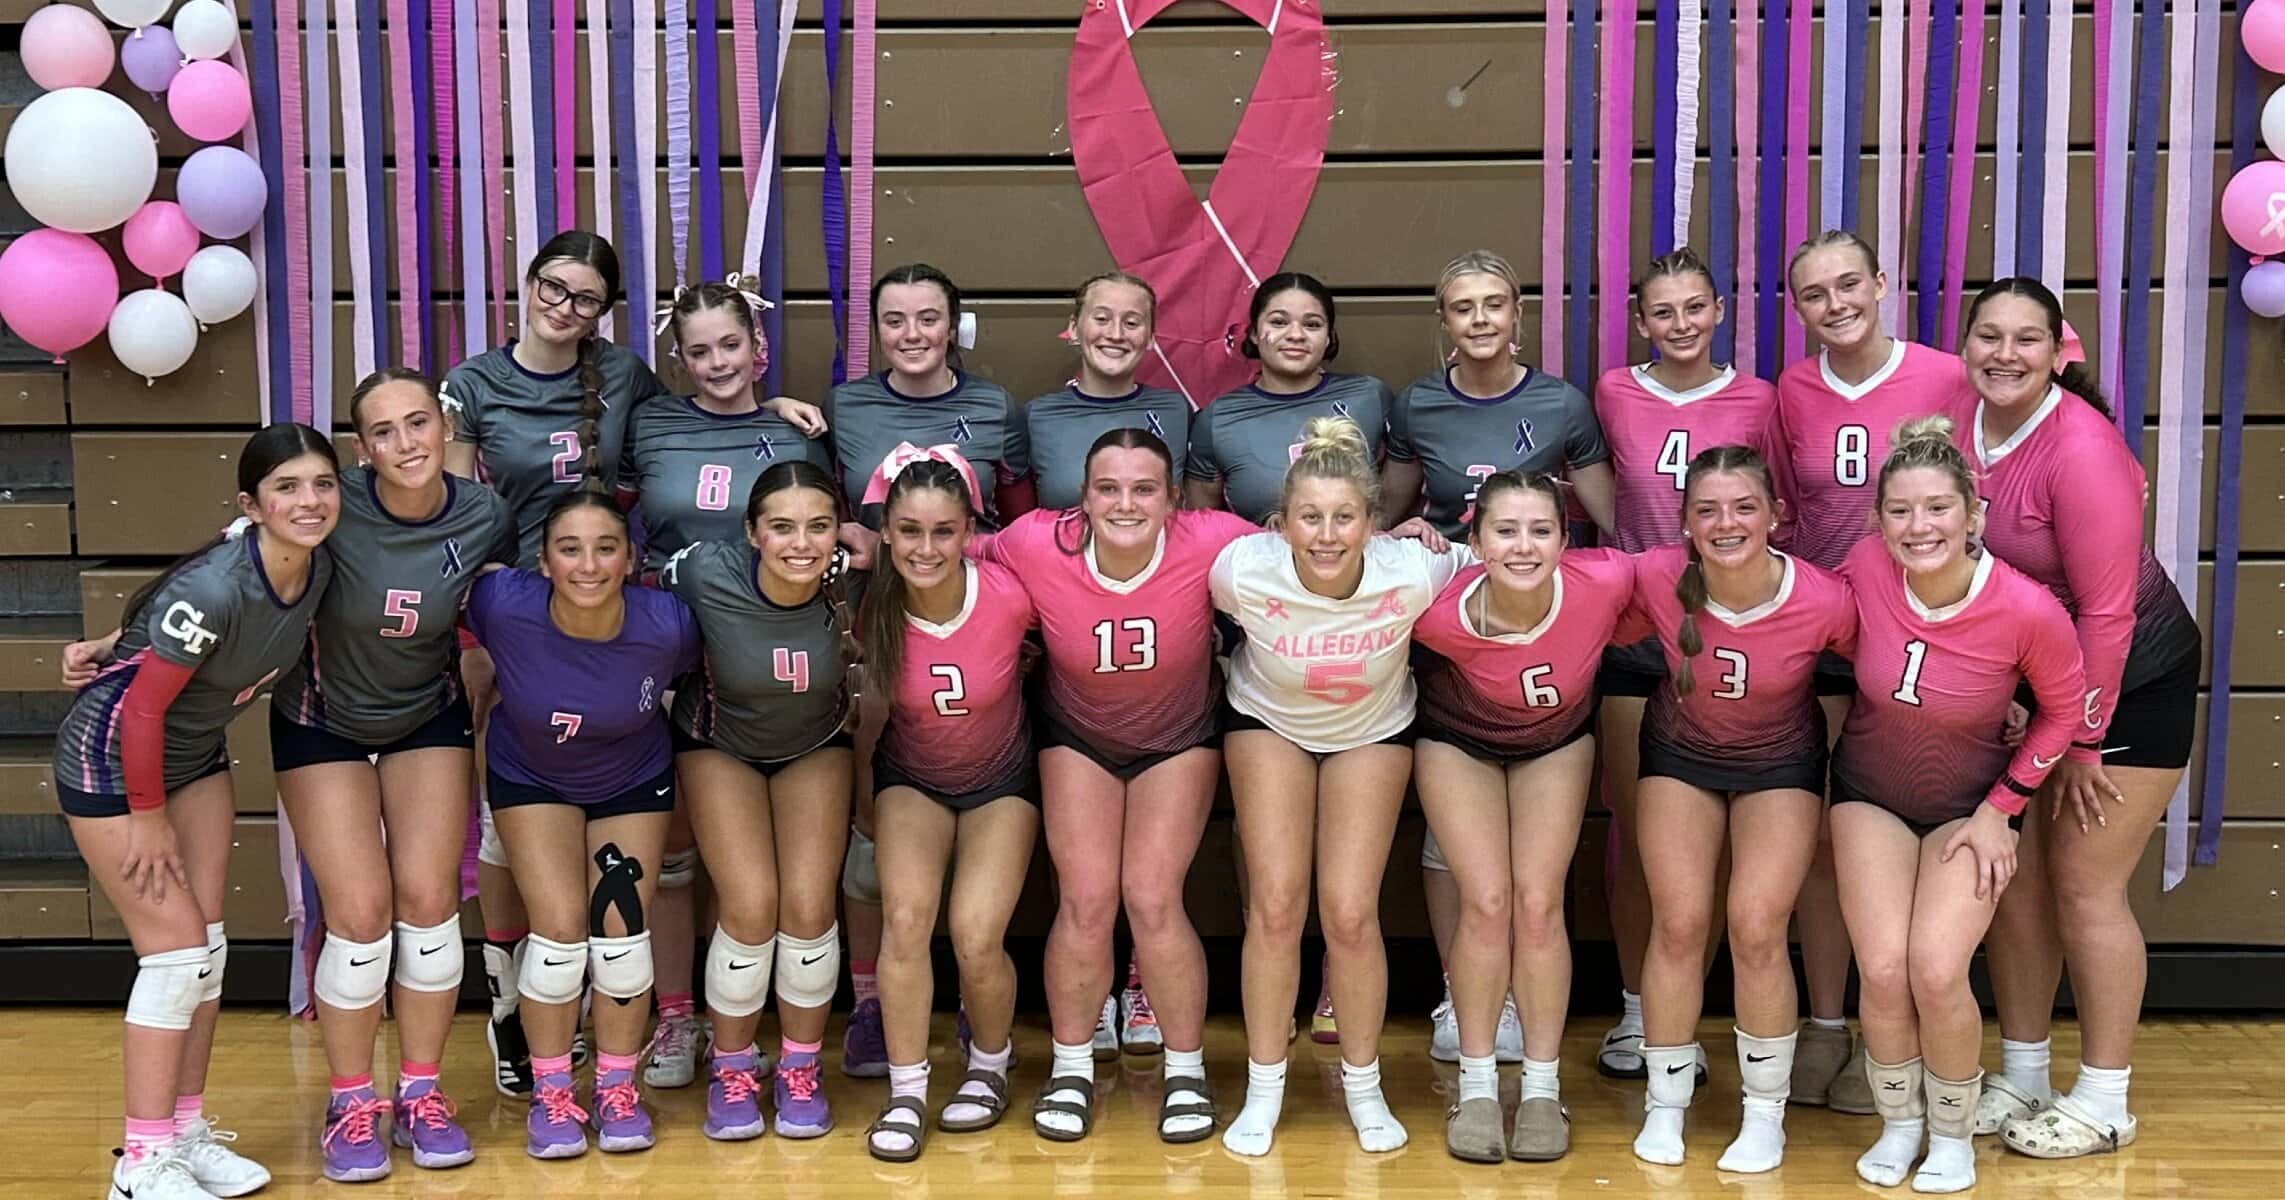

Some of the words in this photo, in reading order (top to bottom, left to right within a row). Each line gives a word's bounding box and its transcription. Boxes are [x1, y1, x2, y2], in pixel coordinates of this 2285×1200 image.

[551, 431, 583, 484] 2
[1656, 430, 1694, 491] 4
[1834, 424, 1870, 487] 8
[696, 463, 732, 511] 8
[161, 600, 218, 654] GT
[380, 589, 421, 638] 5
[1093, 616, 1157, 674] 13
[1272, 628, 1397, 658] ALLEGAN
[773, 647, 810, 693] 4
[929, 664, 970, 716] 2
[1304, 660, 1373, 705] 5
[1520, 664, 1560, 708] 6
[1713, 648, 1748, 700] 3
[1893, 639, 1927, 706] 1
[551, 711, 582, 744] 7
